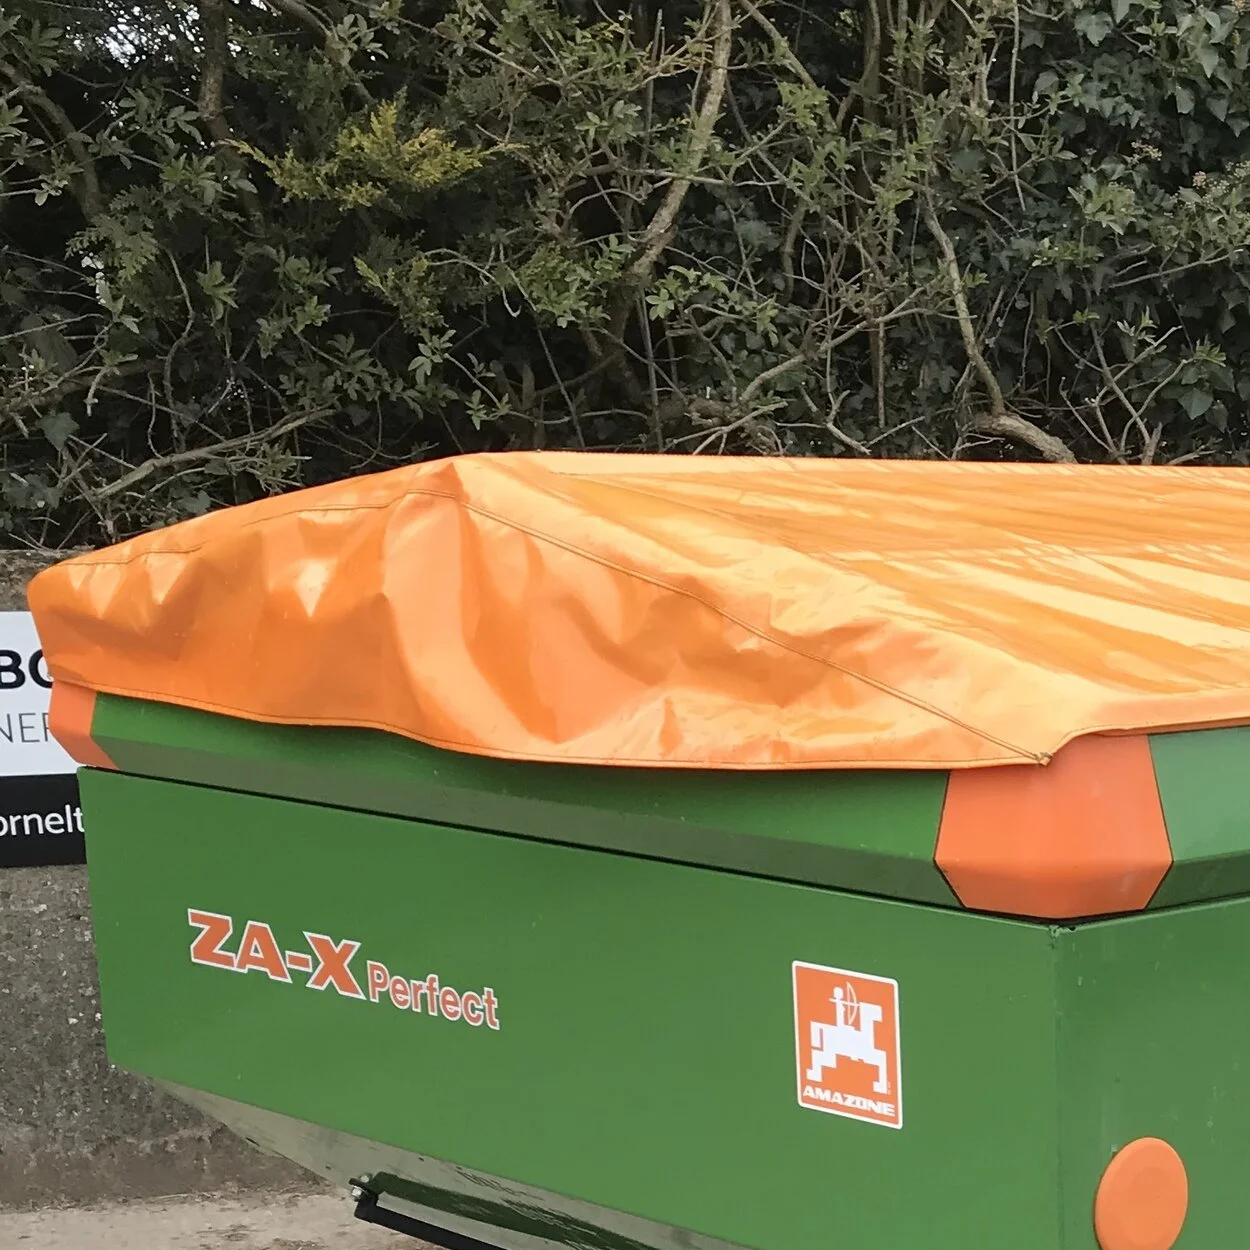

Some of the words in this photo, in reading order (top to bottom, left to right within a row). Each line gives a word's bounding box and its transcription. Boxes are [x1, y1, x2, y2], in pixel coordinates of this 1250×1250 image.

[187, 908, 367, 1001] ZA-X
[367, 960, 500, 1031] Perfect
[803, 1085, 896, 1117] AMAZONE
